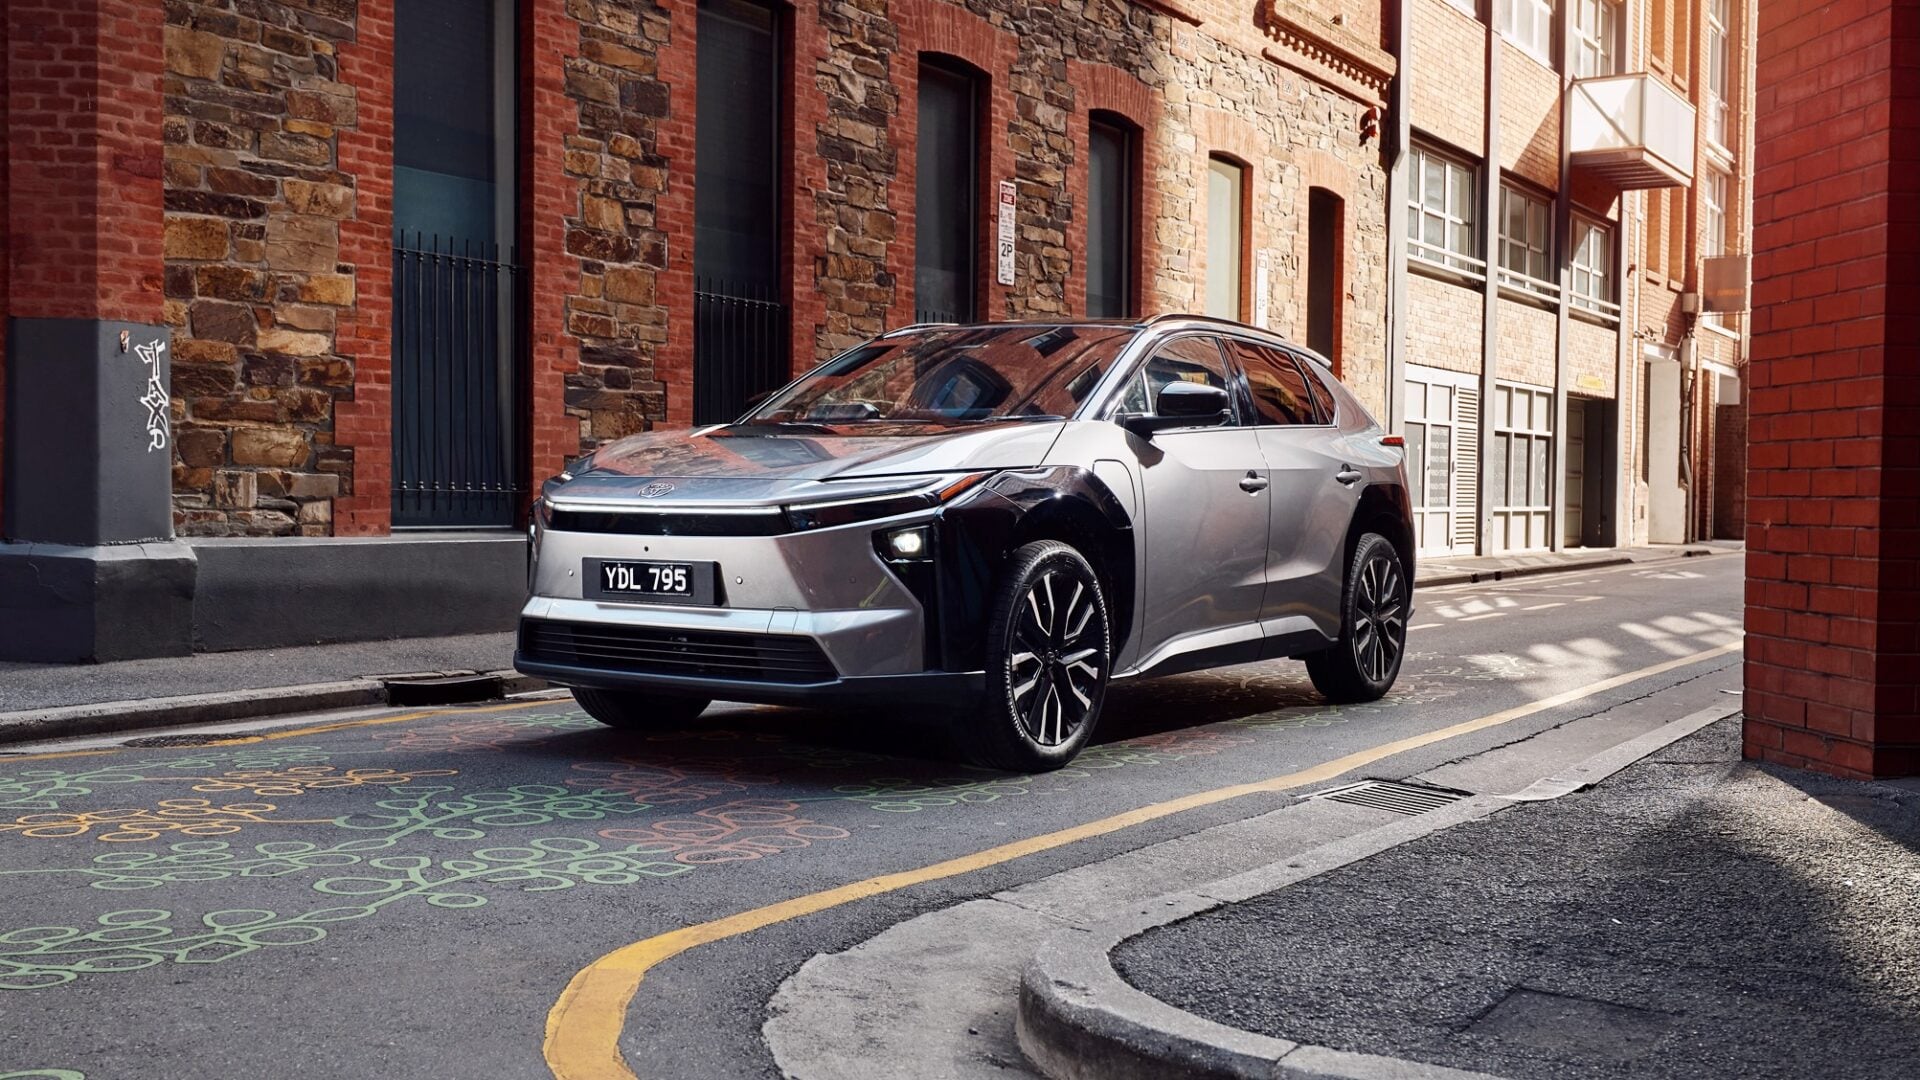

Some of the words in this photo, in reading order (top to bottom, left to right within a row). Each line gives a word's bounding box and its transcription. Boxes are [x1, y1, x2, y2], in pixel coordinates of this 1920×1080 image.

[1001, 243, 1013, 257] 2P
[605, 567, 641, 590] YDL
[648, 567, 687, 592] 795
